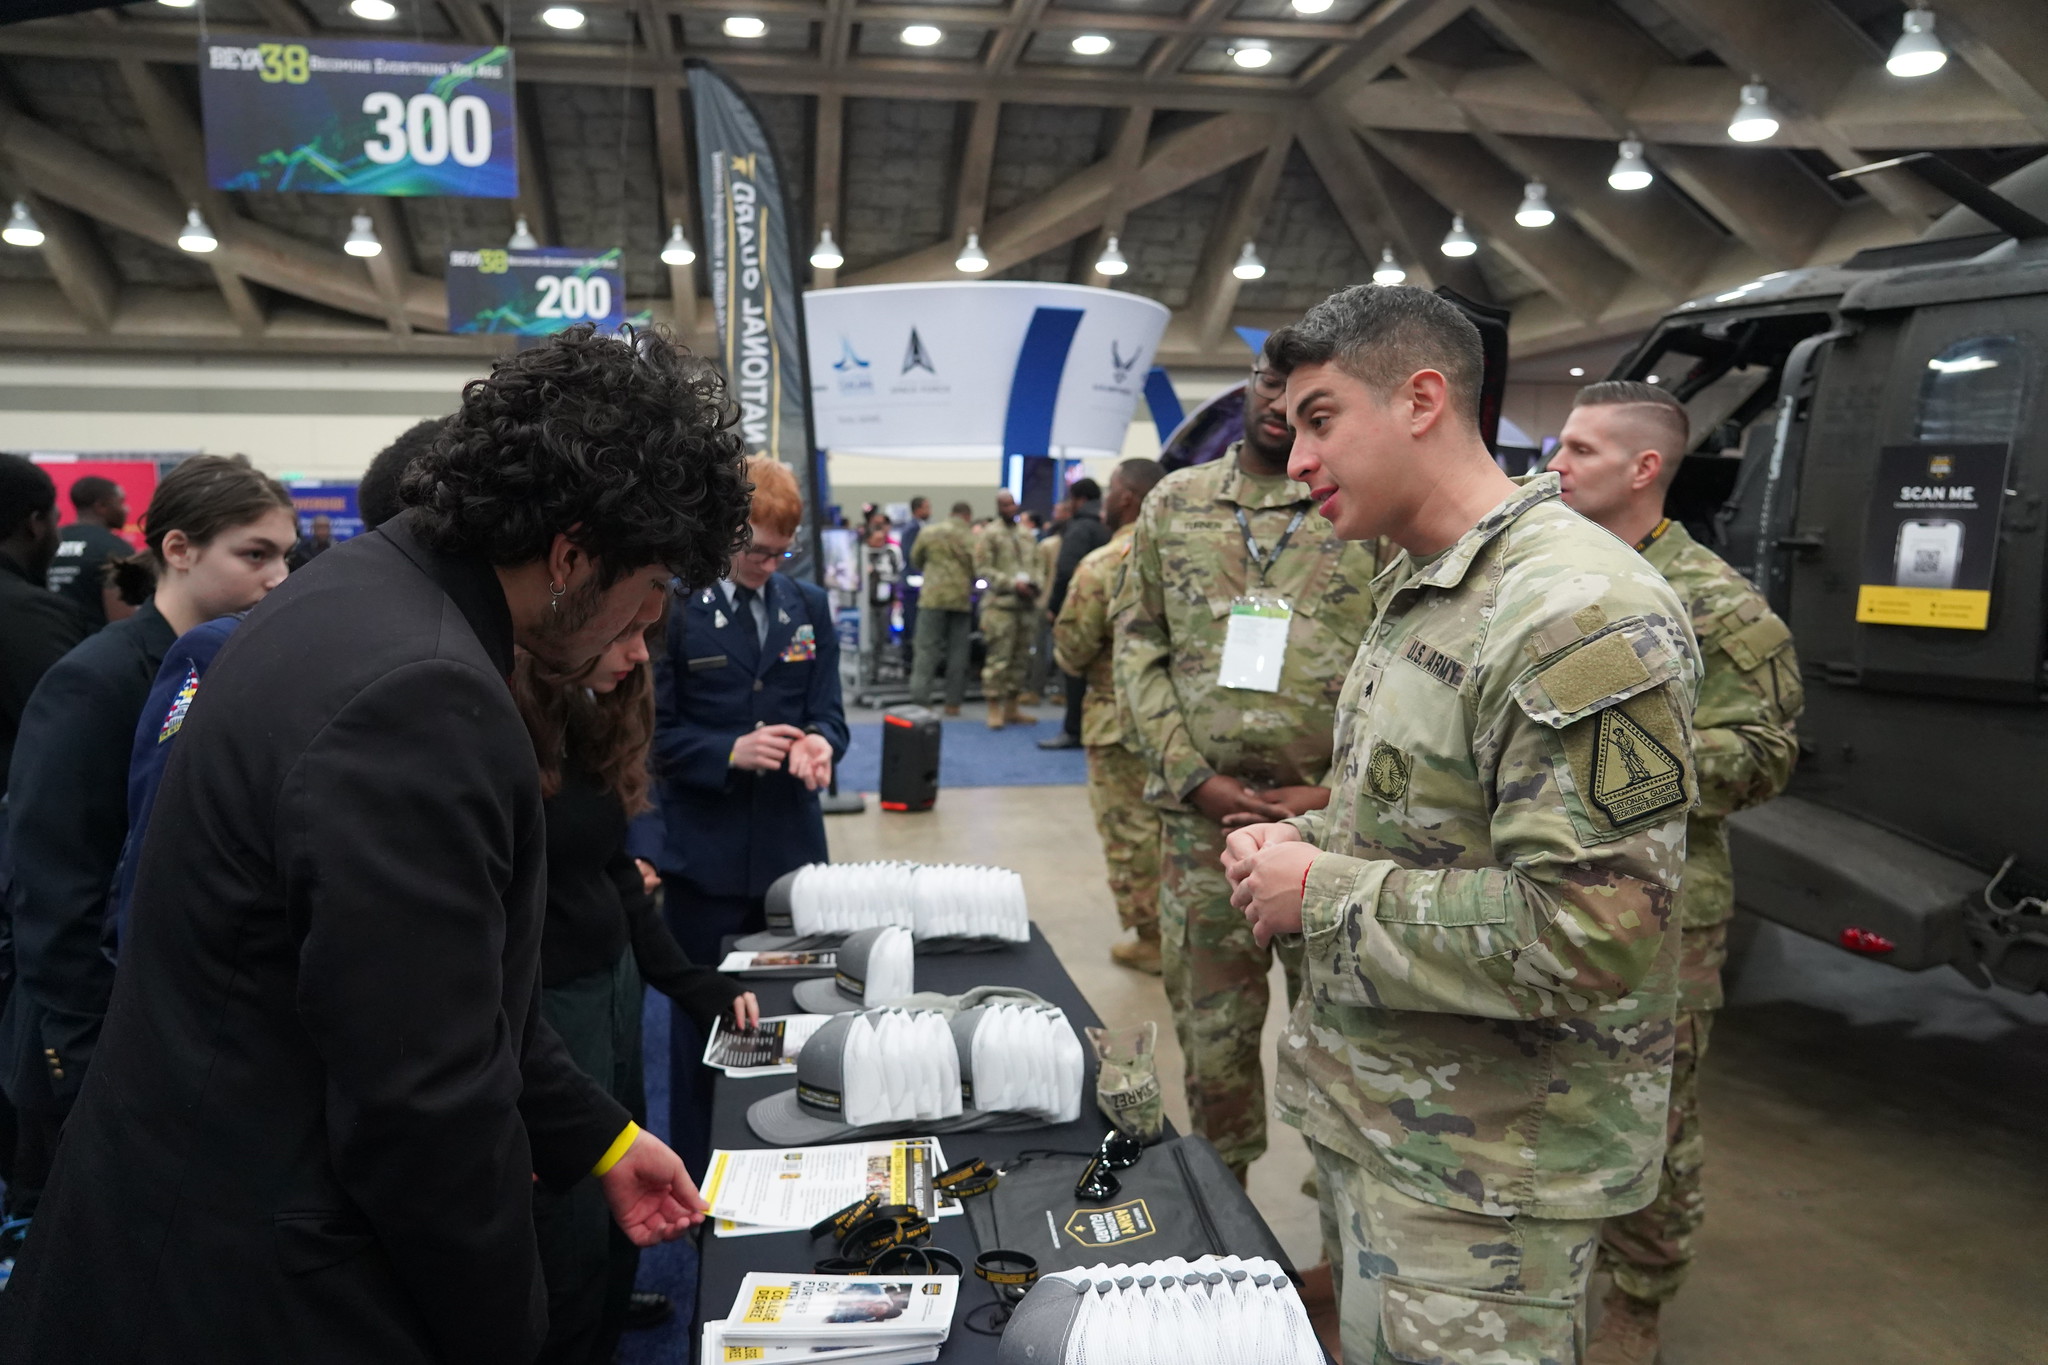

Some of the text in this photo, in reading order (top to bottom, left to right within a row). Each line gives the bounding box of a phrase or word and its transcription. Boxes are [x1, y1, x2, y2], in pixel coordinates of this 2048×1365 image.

[362, 91, 492, 167] 300
[535, 275, 611, 319] 200
[1900, 486, 1975, 501] SCAN ME
[1407, 640, 1462, 684] U.S. ARMY
[1610, 783, 1677, 812] NATIONAL GUARD
[1089, 1213, 1111, 1243] GUARD
[1103, 1211, 1121, 1241] NATIONAL
[1114, 1208, 1137, 1235] ARMY
[788, 1280, 801, 1300] WITH
[817, 1281, 830, 1293] GO
[749, 1289, 770, 1318] DEGREE
[762, 1290, 784, 1321] COLLEGE
